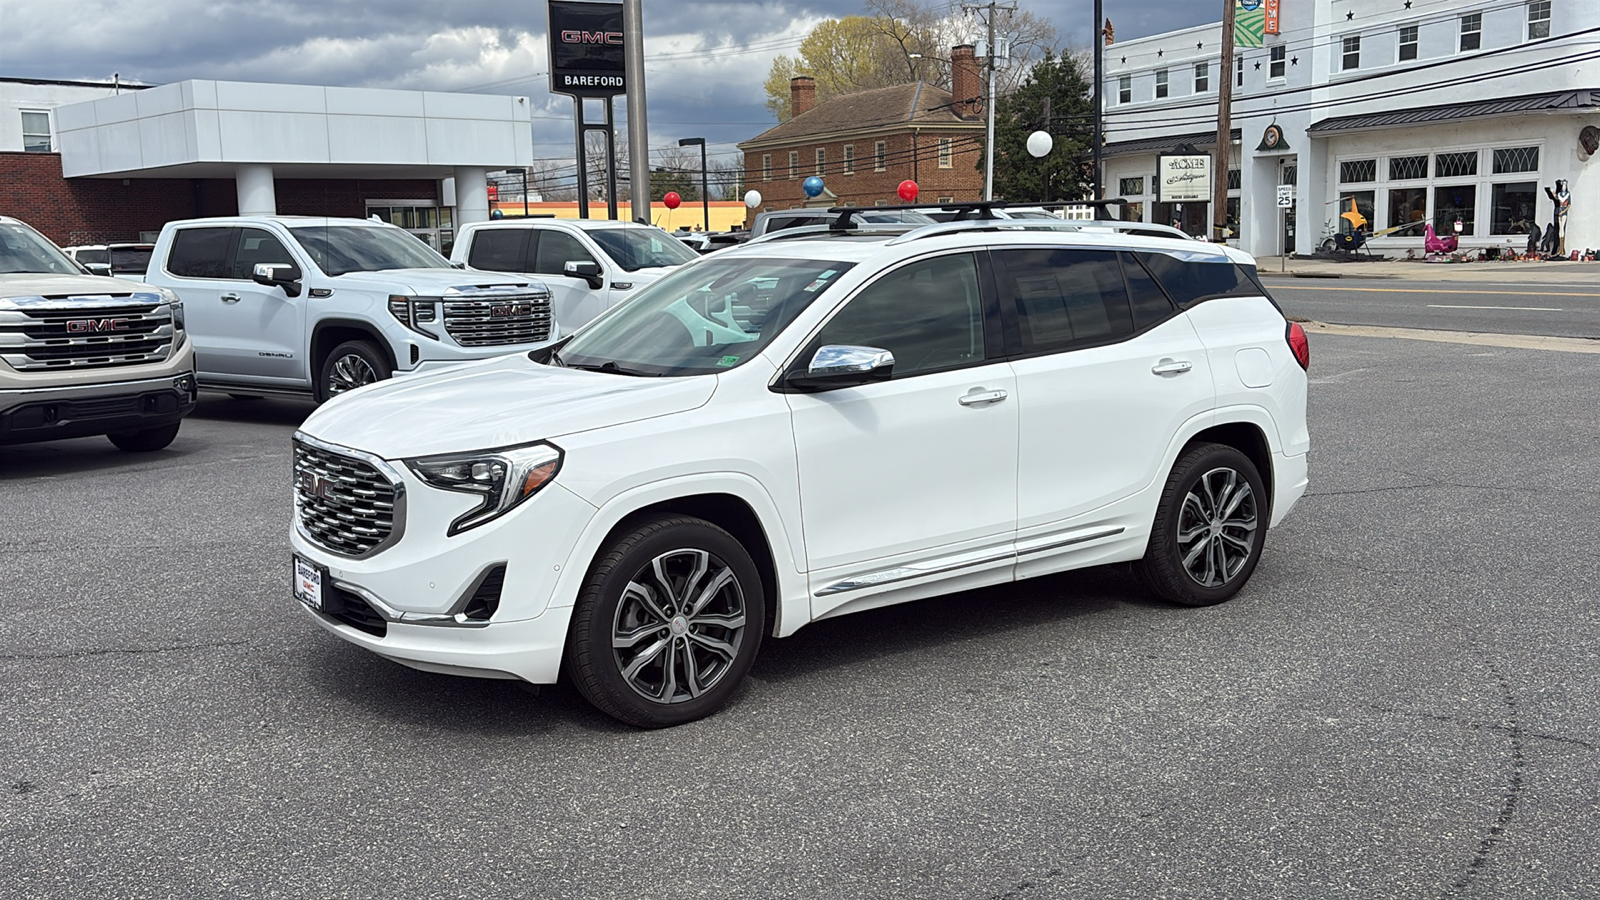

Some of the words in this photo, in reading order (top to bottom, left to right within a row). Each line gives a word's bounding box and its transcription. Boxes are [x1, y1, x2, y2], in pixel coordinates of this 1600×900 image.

[561, 30, 623, 44] GMC
[564, 75, 624, 86] BAREFORD
[1278, 196, 1291, 205] 25
[491, 304, 530, 316] GMC
[66, 318, 130, 333] GMC
[300, 468, 337, 501] GMC
[298, 564, 320, 585] BAREFORD
[302, 580, 315, 593] GMC
